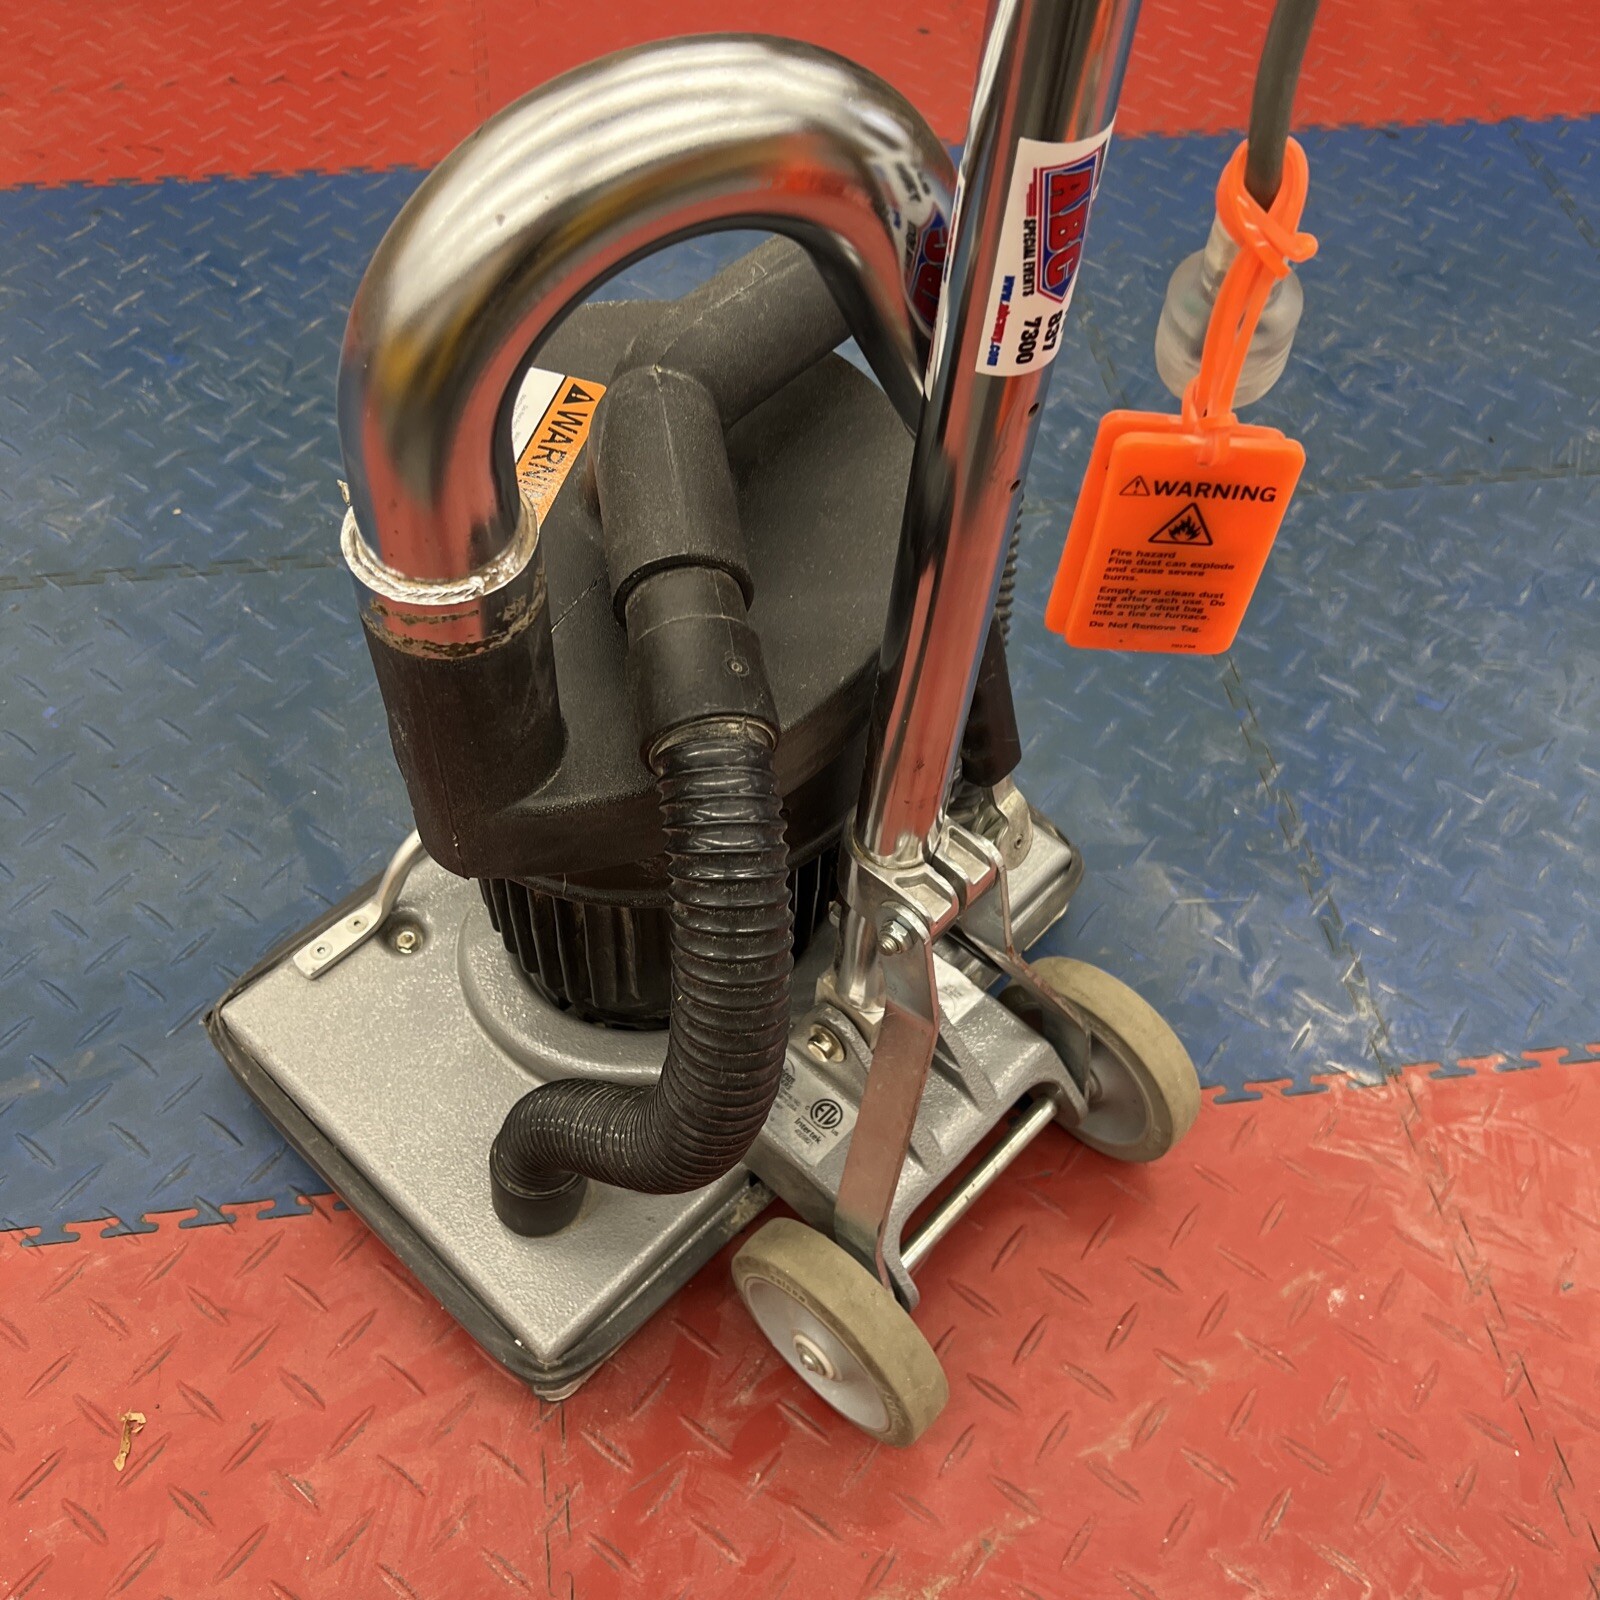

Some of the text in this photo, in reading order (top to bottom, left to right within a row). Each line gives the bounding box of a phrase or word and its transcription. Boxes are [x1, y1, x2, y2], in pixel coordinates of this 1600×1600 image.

[1045, 167, 1092, 289] ABC
[1022, 218, 1036, 297] SPECIAL EVENTS
[1015, 316, 1043, 364] 7300
[1042, 309, 1063, 351] 837
[1154, 480, 1277, 503] WARNING
[1108, 557, 1132, 565] Fine
[1136, 558, 1162, 567] dust
[1110, 549, 1175, 559] Fire hazard
[1100, 586, 1136, 596] Empty
[1165, 589, 1194, 597] clean
[1199, 591, 1224, 599] dust
[1183, 598, 1204, 606] use.
[1210, 599, 1225, 607] Do
[1116, 603, 1151, 611] empty
[1155, 603, 1179, 611] dust
[1183, 605, 1204, 614] bag
[1108, 621, 1128, 629] Not
[1132, 622, 1175, 631] Remove
[815, 1102, 838, 1126] ETL
[794, 1117, 821, 1144] Intertek
